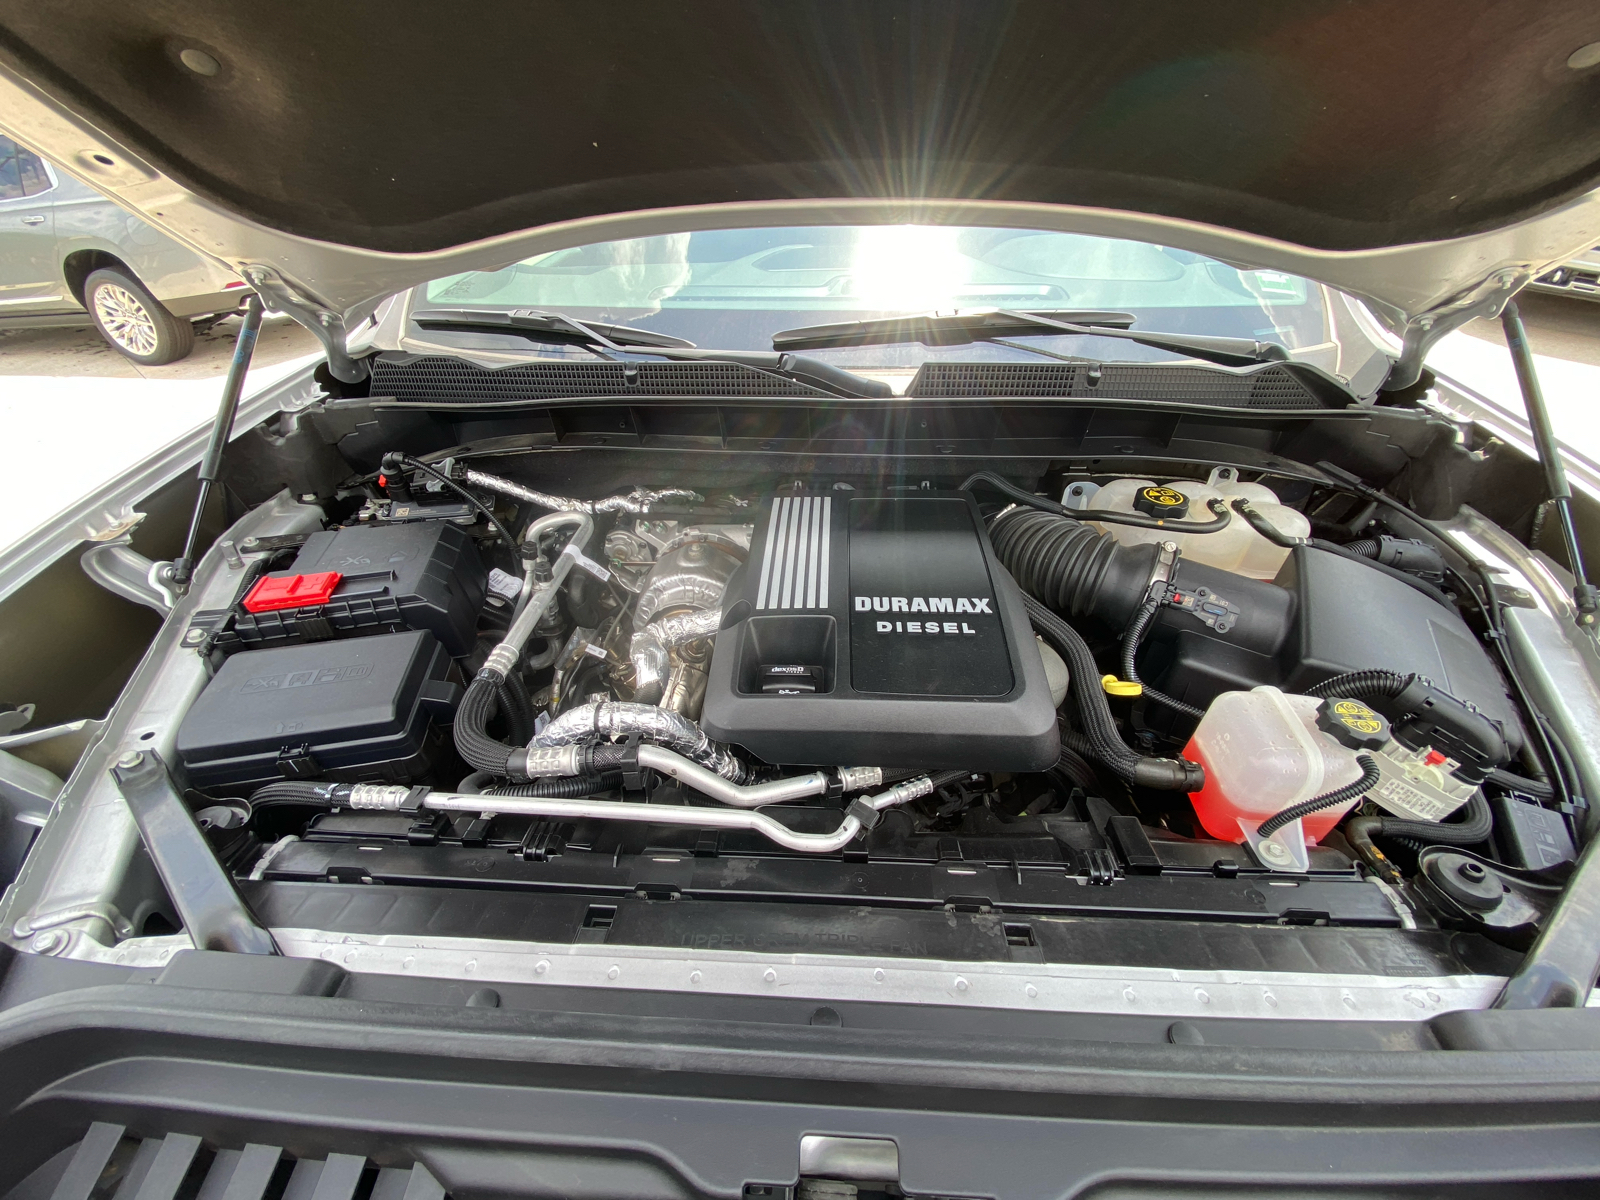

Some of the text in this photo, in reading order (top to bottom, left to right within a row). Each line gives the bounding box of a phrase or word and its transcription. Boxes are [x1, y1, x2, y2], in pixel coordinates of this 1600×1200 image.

[854, 596, 993, 614] DURAMAX
[876, 621, 976, 634] DIESEL
[680, 932, 747, 949] UPPER
